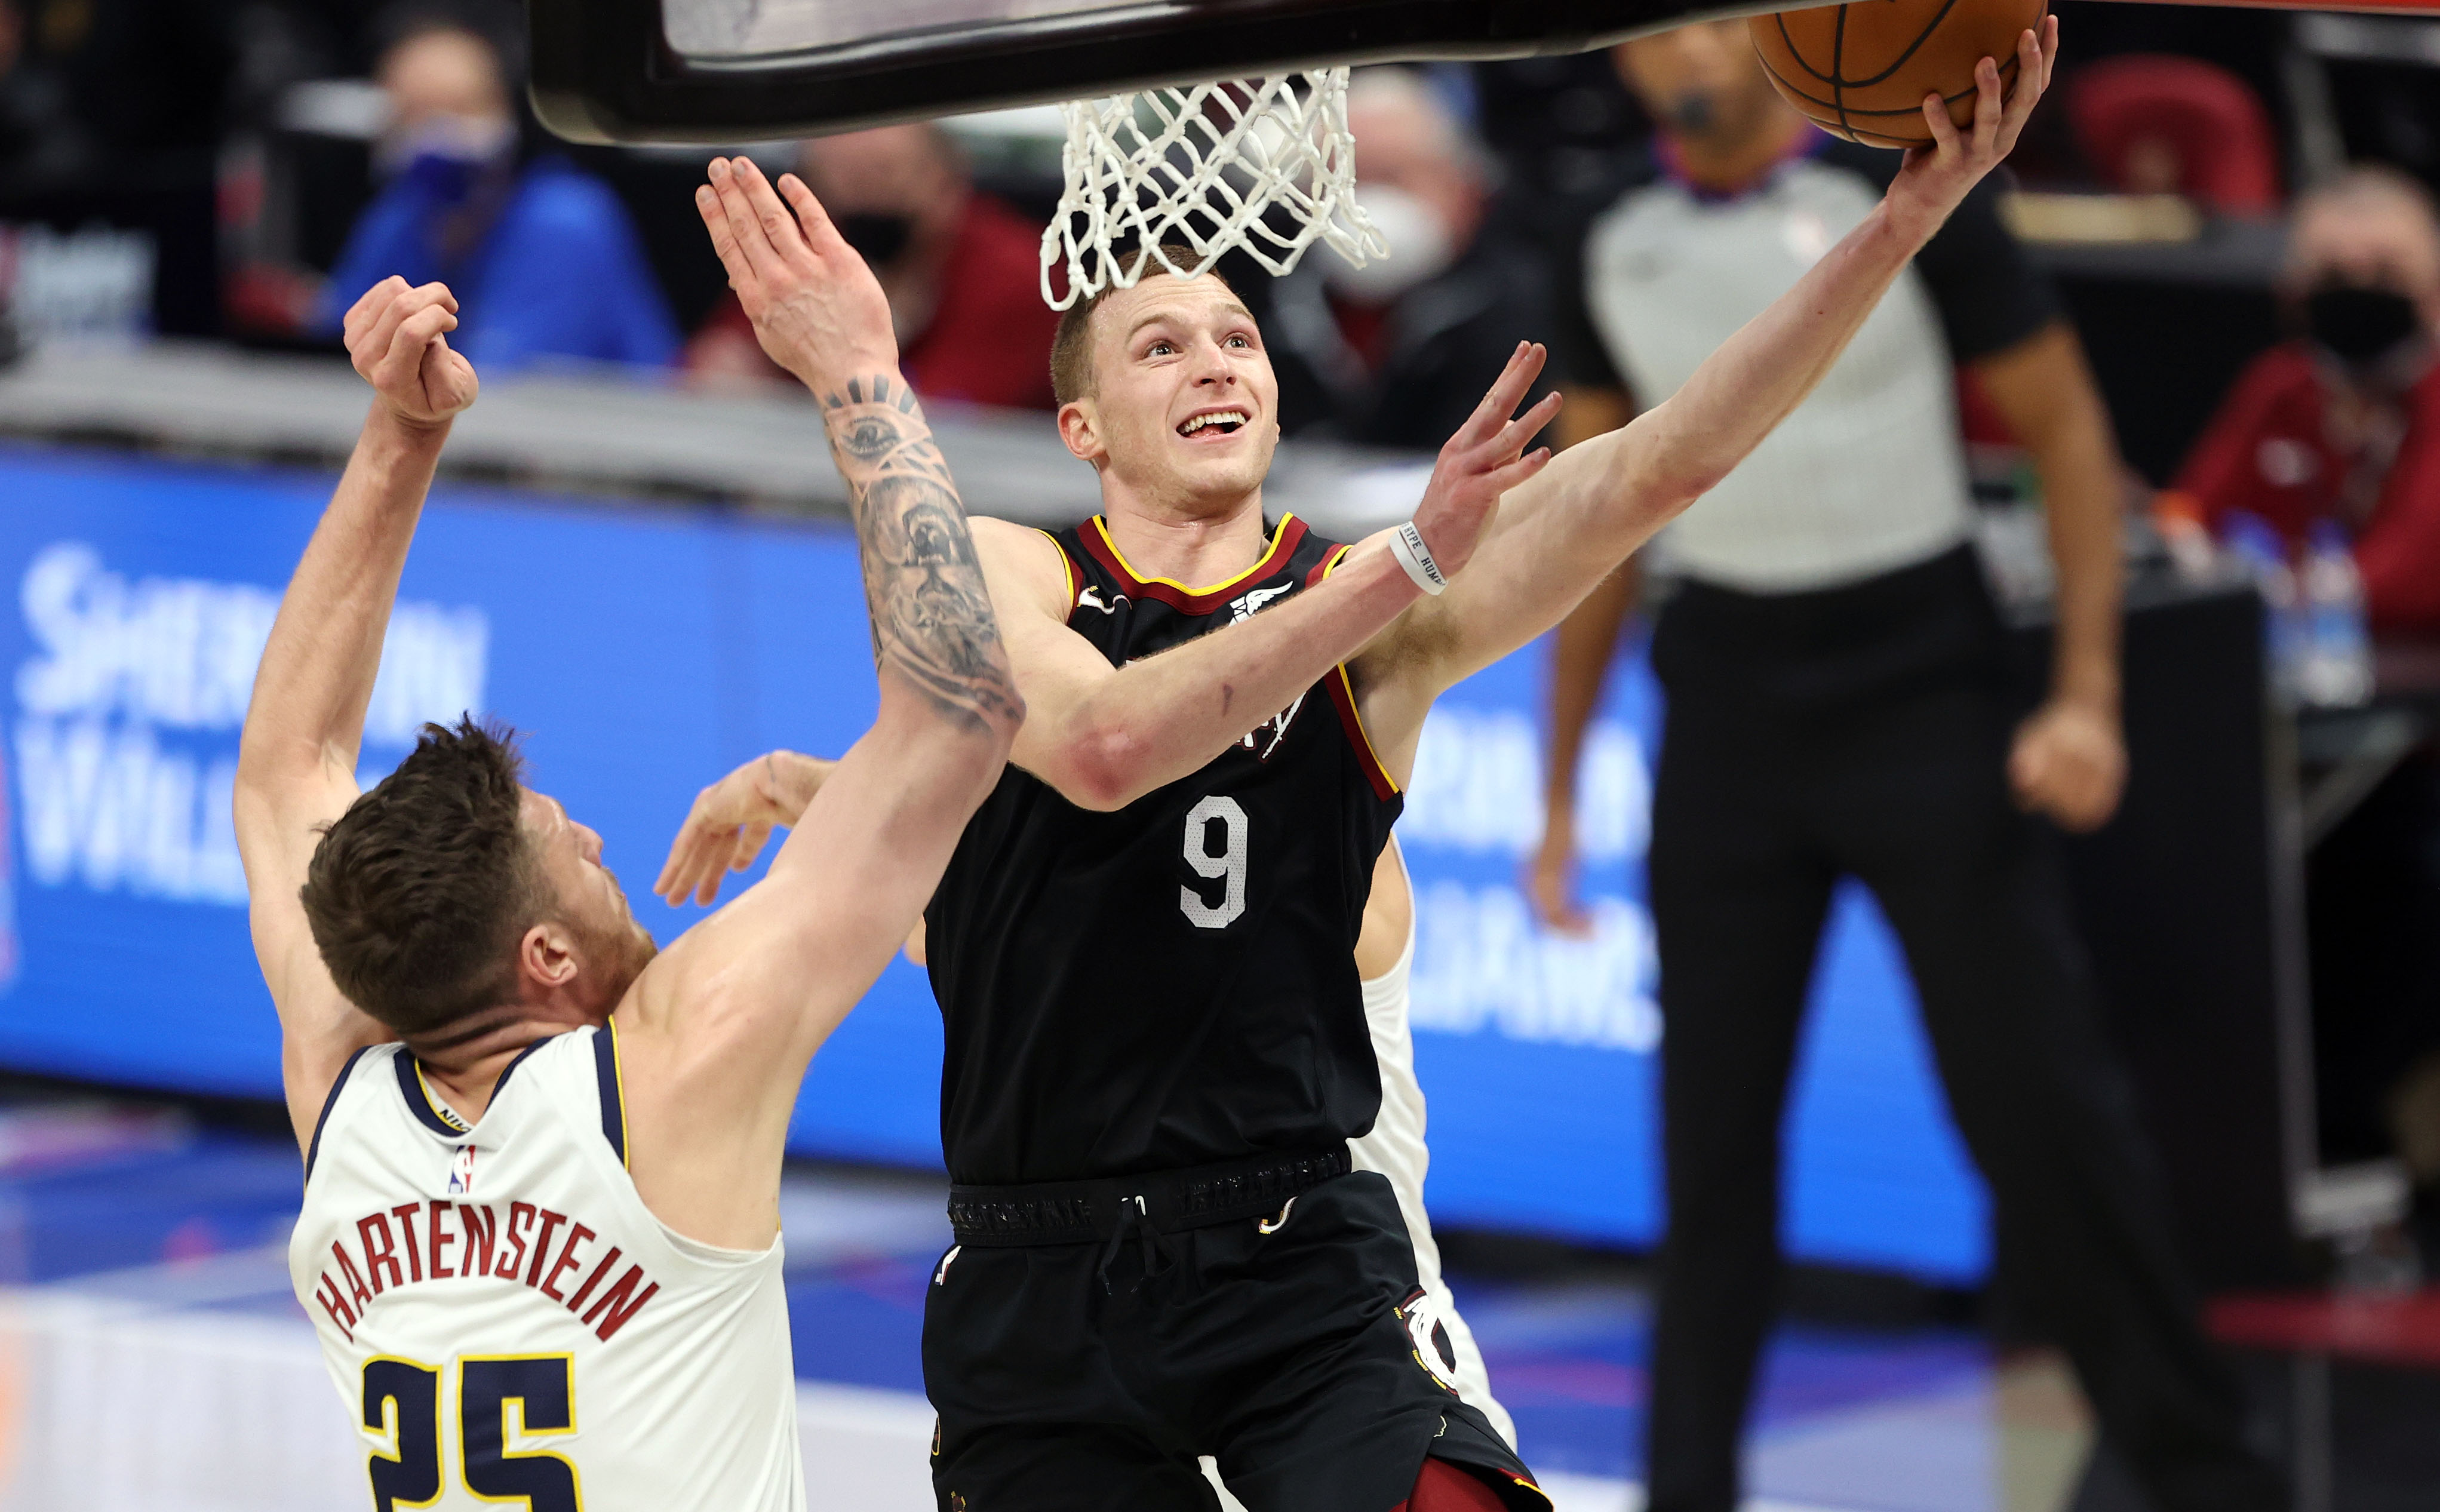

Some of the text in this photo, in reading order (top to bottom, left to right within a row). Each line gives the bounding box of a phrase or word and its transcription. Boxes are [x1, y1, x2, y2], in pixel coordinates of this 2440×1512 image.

[1180, 795, 1248, 929] 9
[315, 1200, 659, 1343] HARTENSTEIN
[360, 1351, 583, 1512] 25
